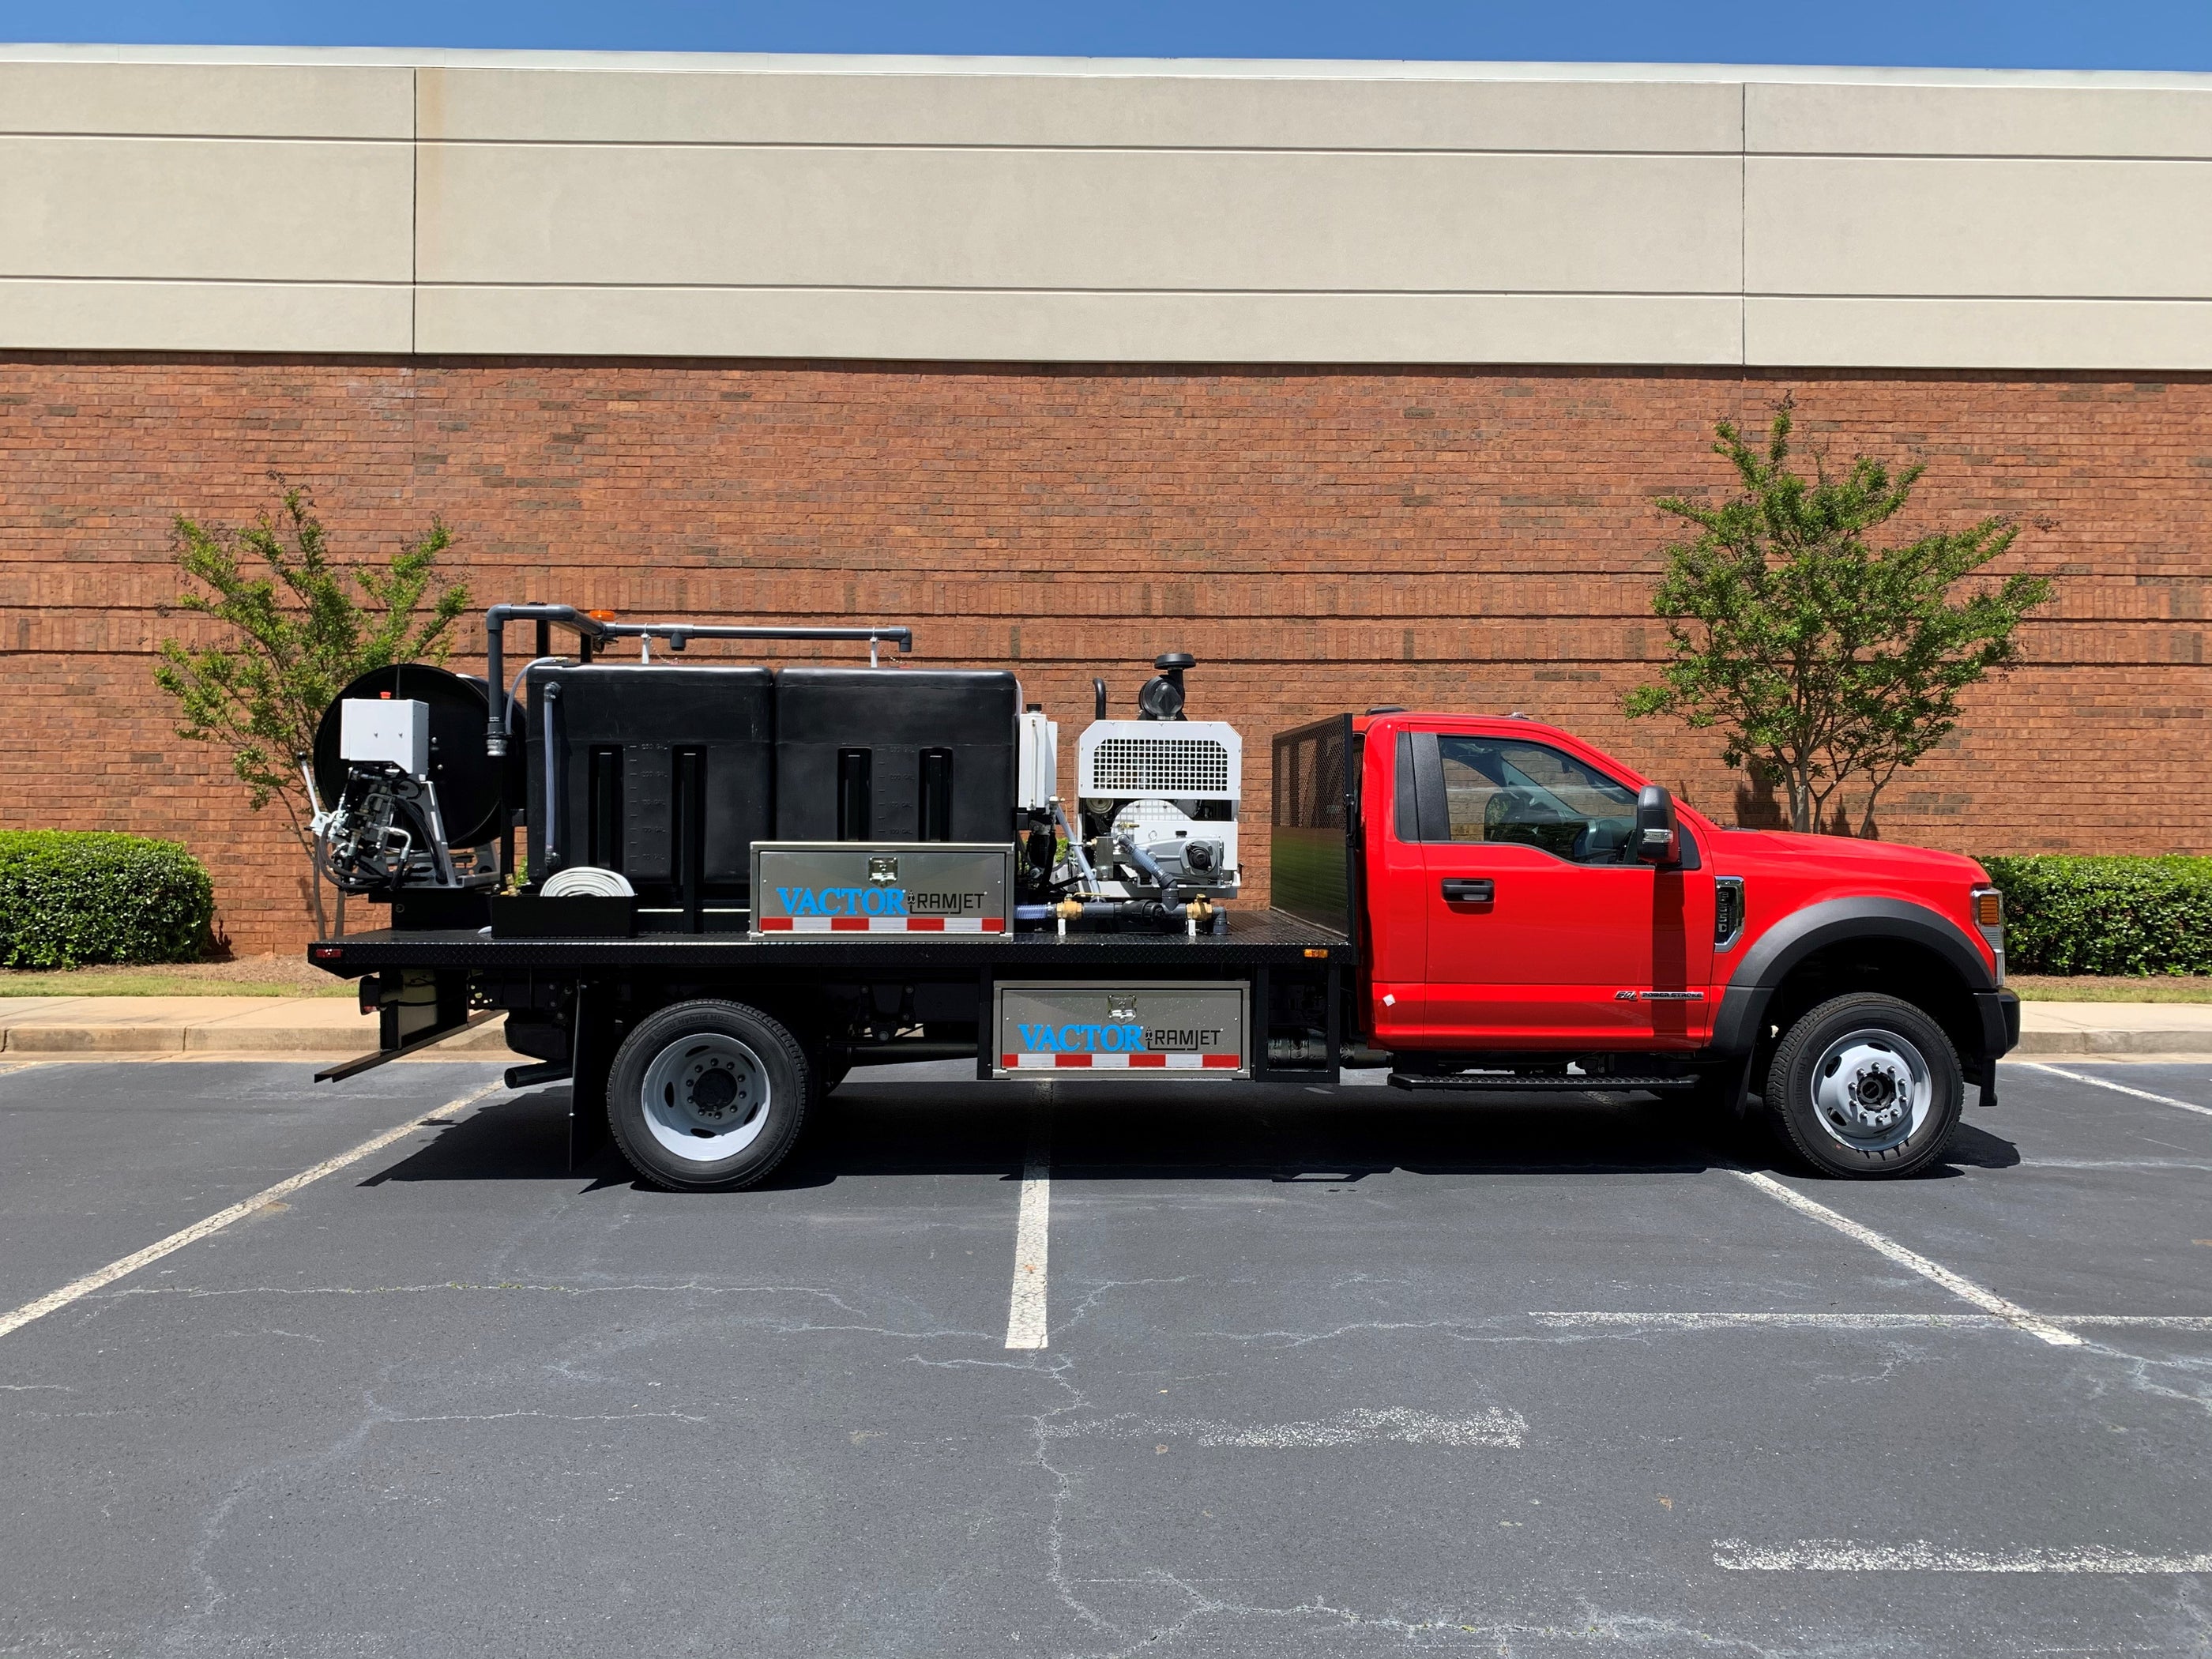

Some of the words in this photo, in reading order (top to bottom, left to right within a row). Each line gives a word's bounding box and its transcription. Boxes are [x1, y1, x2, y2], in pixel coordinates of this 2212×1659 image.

[777, 887, 908, 915] VACTOR
[917, 893, 984, 914] RAMJET
[678, 1014, 708, 1026] Hybrid
[1018, 1024, 1146, 1051] VACTOR
[1154, 1030, 1221, 1051] RAMJET
